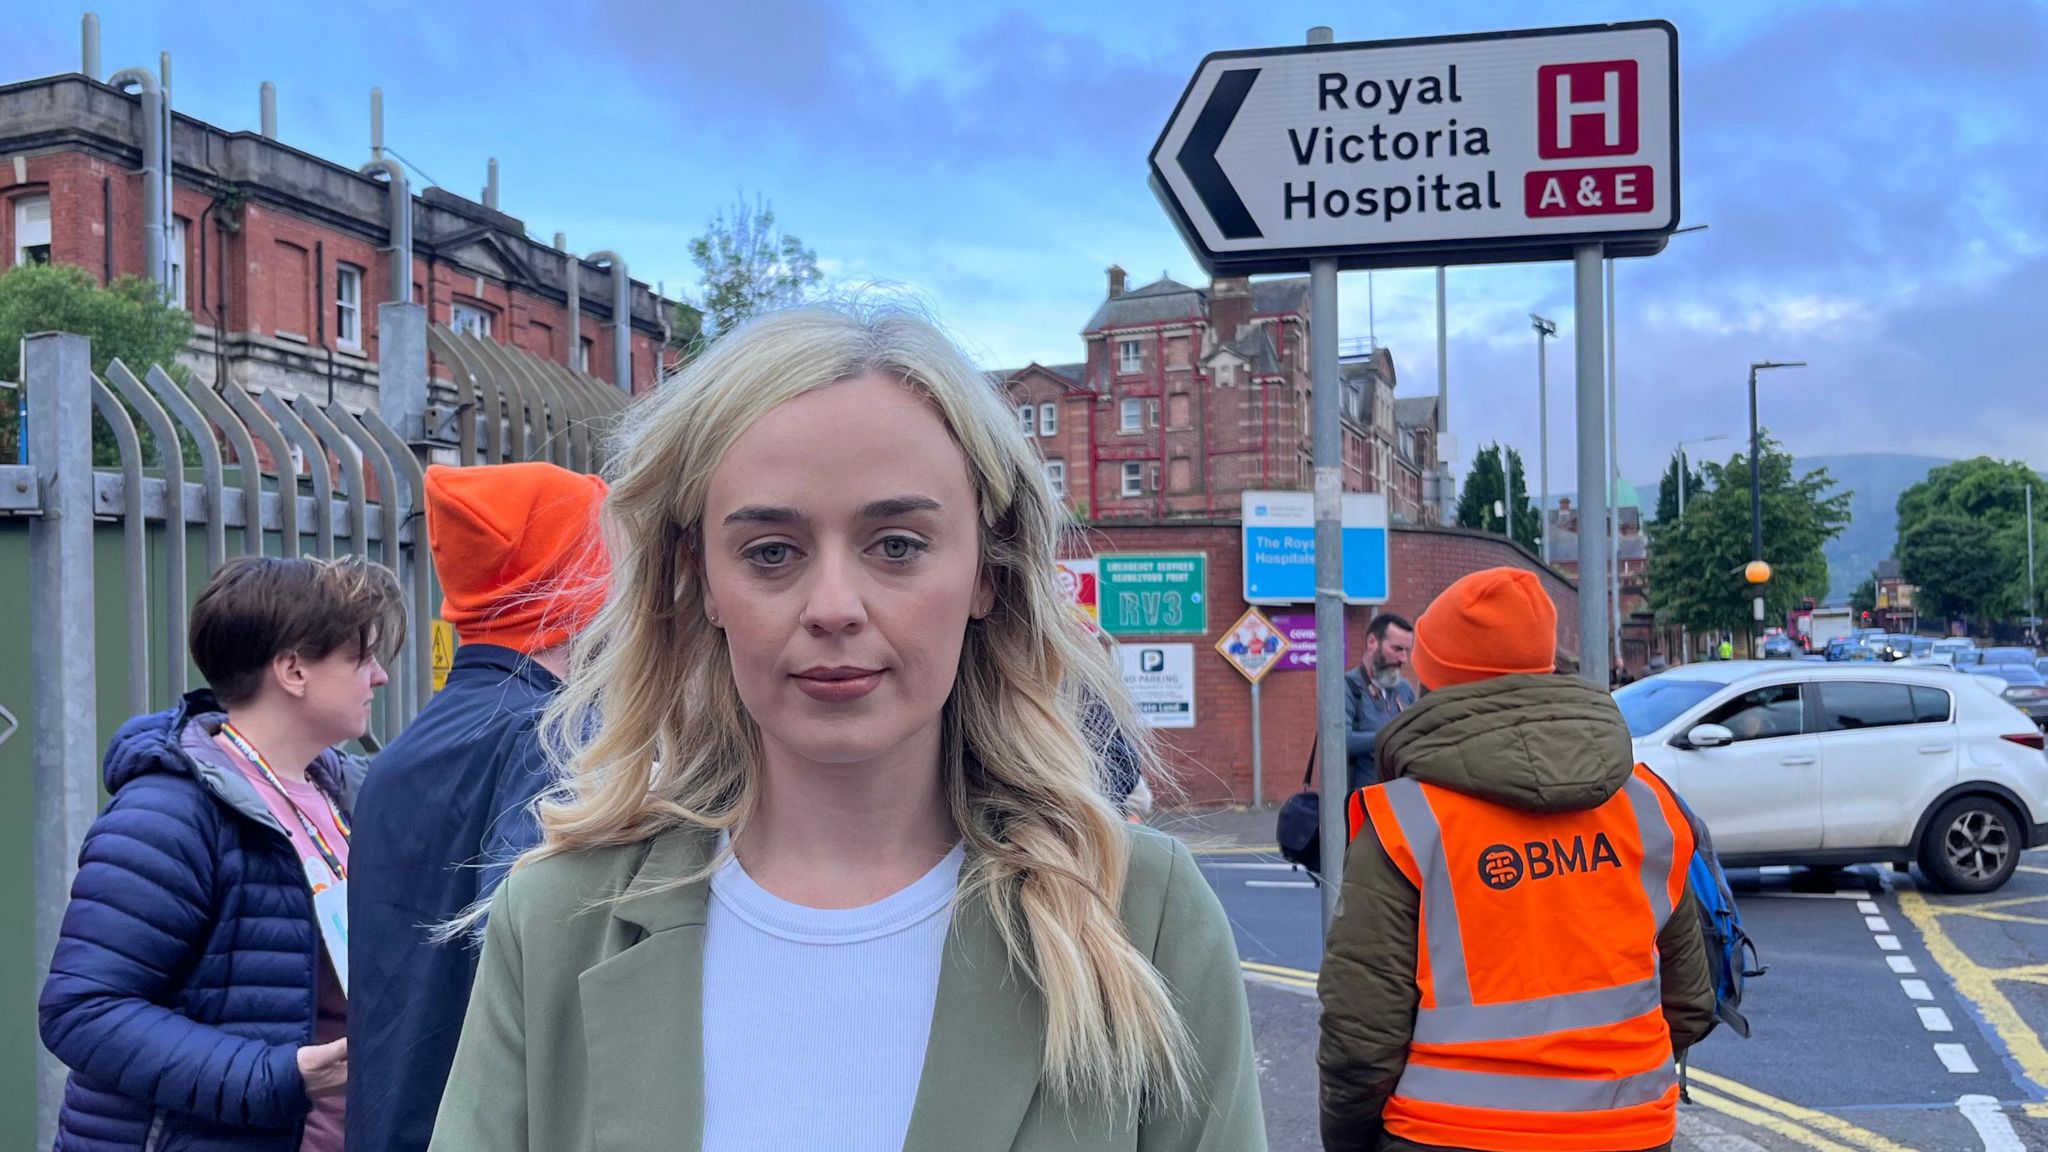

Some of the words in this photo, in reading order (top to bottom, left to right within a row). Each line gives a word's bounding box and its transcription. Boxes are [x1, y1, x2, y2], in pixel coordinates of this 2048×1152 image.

[1318, 64, 1462, 115] Royal
[1556, 71, 1619, 149] H
[1287, 118, 1490, 166] Victoria
[1284, 170, 1501, 223] Hospital
[1539, 177, 1567, 209] A
[1576, 175, 1602, 207] &
[1615, 173, 1638, 206] E
[1256, 536, 1280, 548] The
[1284, 536, 1315, 551] Roya
[1106, 562, 1154, 573] EMERGENCY
[1157, 562, 1195, 572] SERVICES
[1119, 591, 1183, 626] RV3
[1139, 675, 1178, 684] PARKING
[1524, 832, 1622, 880] BMA
